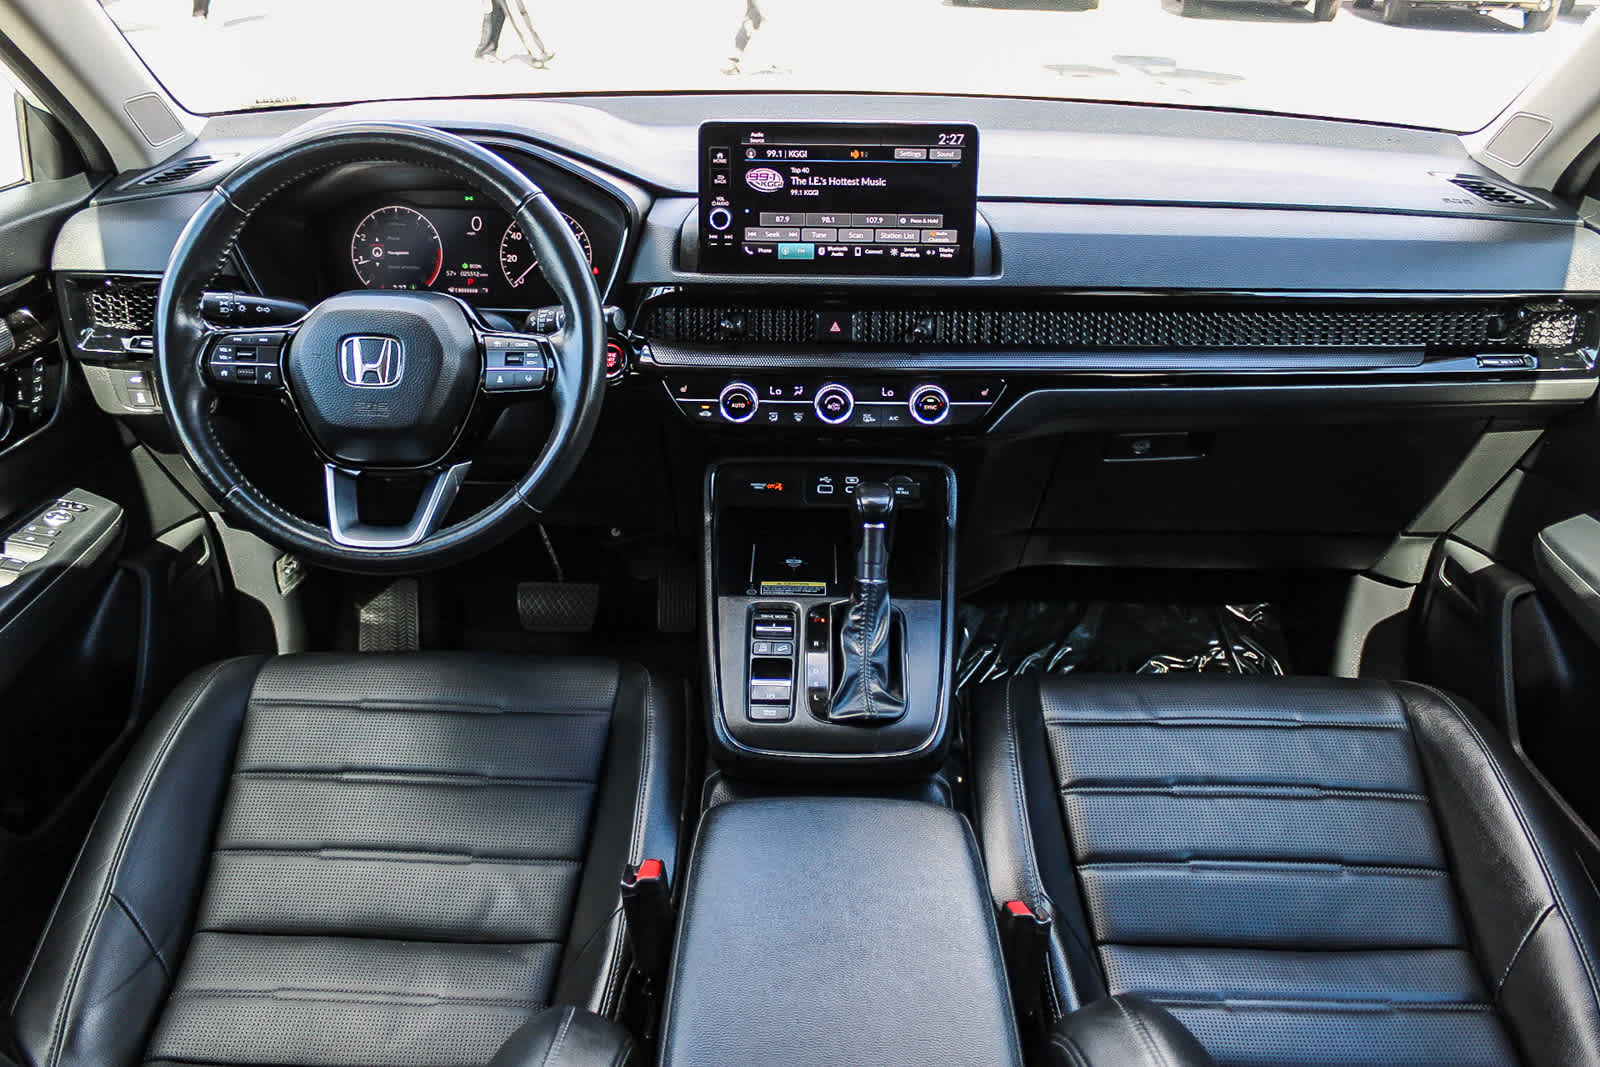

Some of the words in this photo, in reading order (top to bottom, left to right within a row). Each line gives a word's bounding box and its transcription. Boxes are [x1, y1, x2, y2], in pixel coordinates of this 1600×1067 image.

[938, 133, 965, 145] 2:27
[766, 149, 783, 158] 99.1
[788, 149, 808, 158] KGGI
[748, 172, 777, 181] 99.1
[790, 176, 807, 186] The
[828, 177, 860, 187] Hottest
[861, 177, 887, 187] Music
[775, 215, 791, 223] 87.9
[471, 216, 482, 232] 0
[511, 232, 523, 241] 40
[764, 230, 781, 238] Seek
[812, 231, 828, 239] Tune
[880, 232, 902, 240] Station
[506, 254, 518, 263] 20
